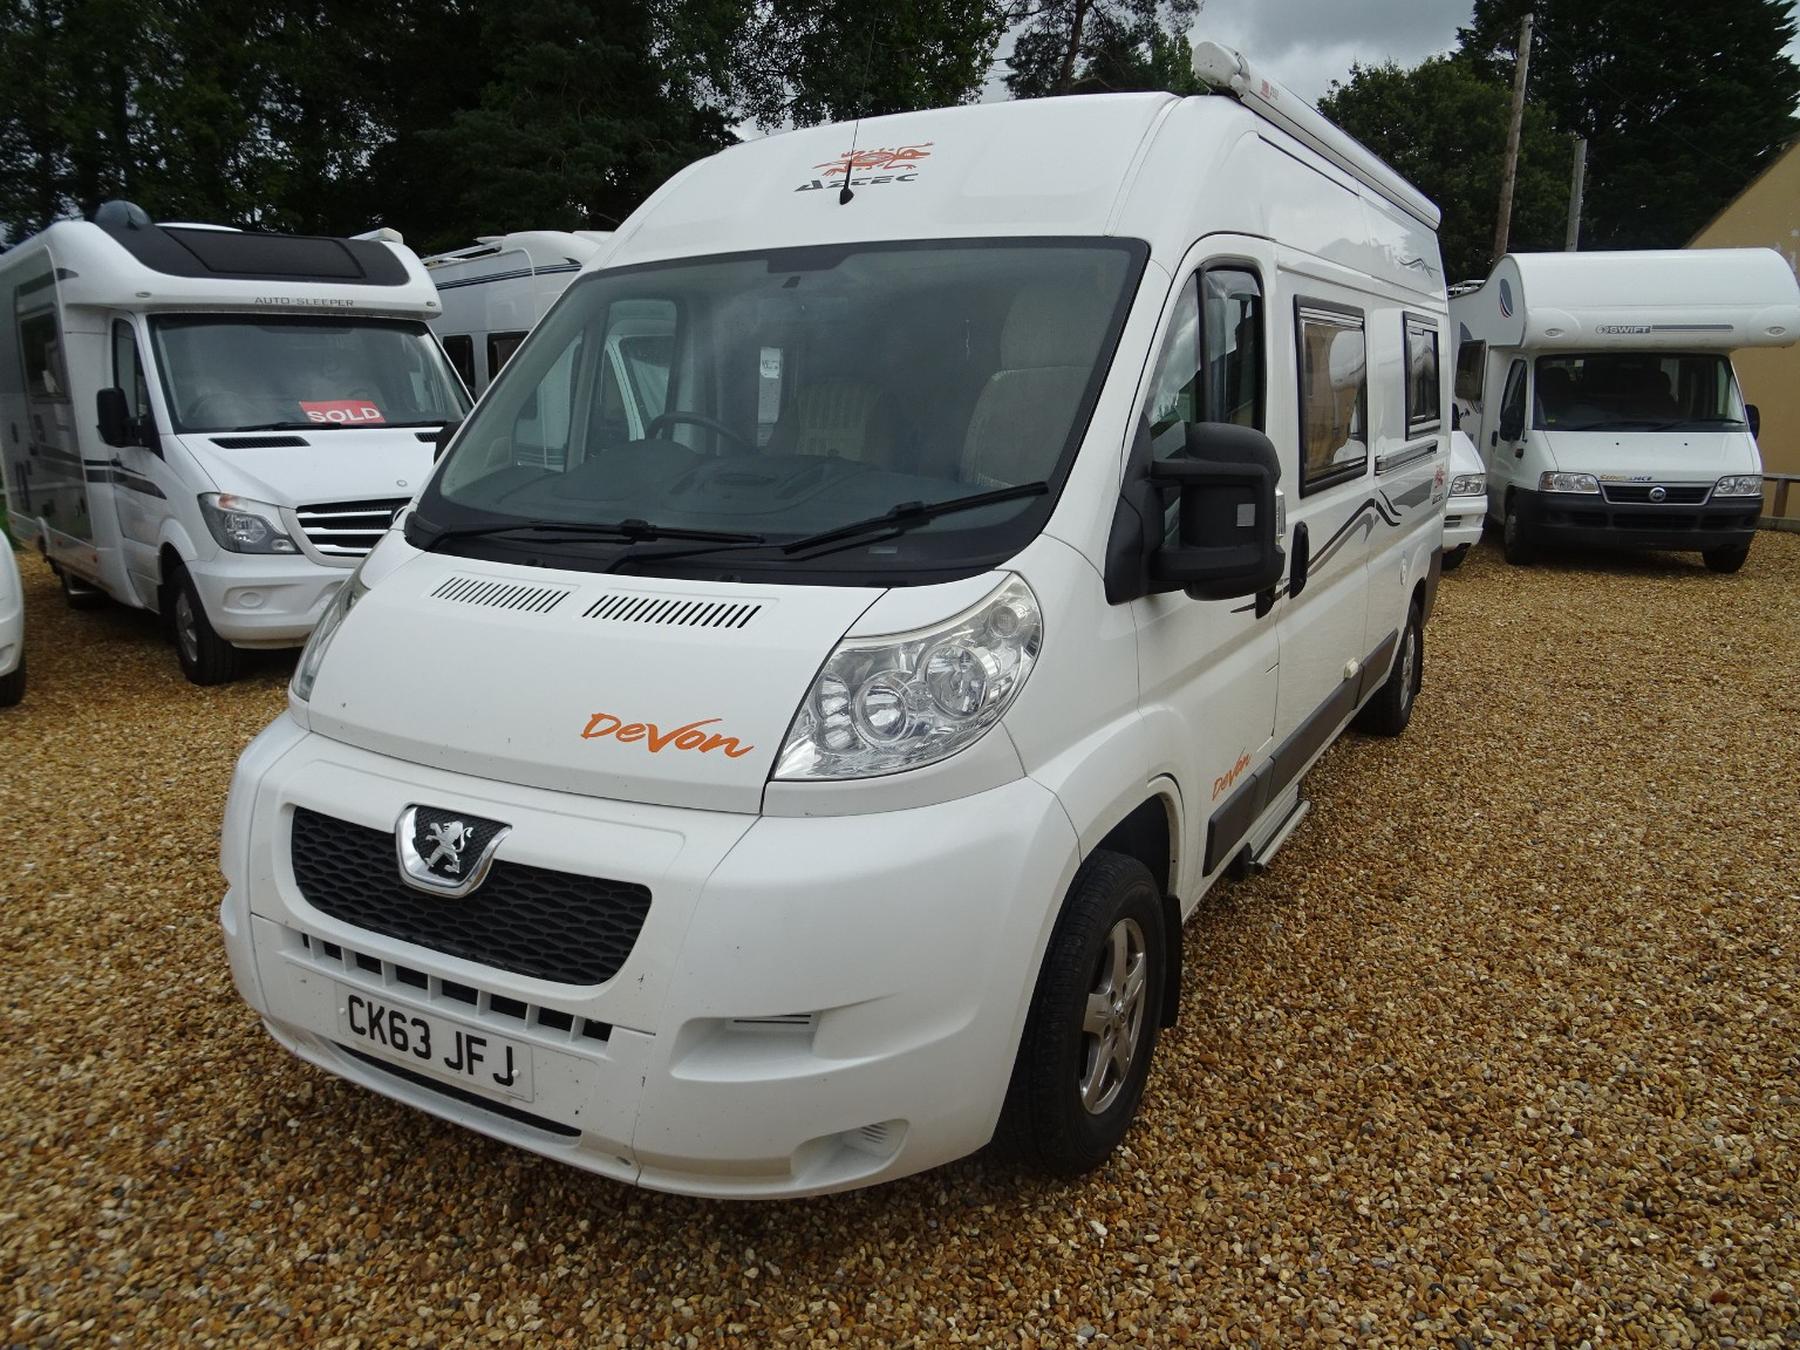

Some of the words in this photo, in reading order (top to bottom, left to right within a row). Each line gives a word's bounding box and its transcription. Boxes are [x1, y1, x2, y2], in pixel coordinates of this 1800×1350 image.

[1608, 325, 1650, 334] SWIFT
[306, 407, 381, 423] SOLD
[348, 994, 432, 1060] CK63
[443, 1030, 515, 1087] JFJ
